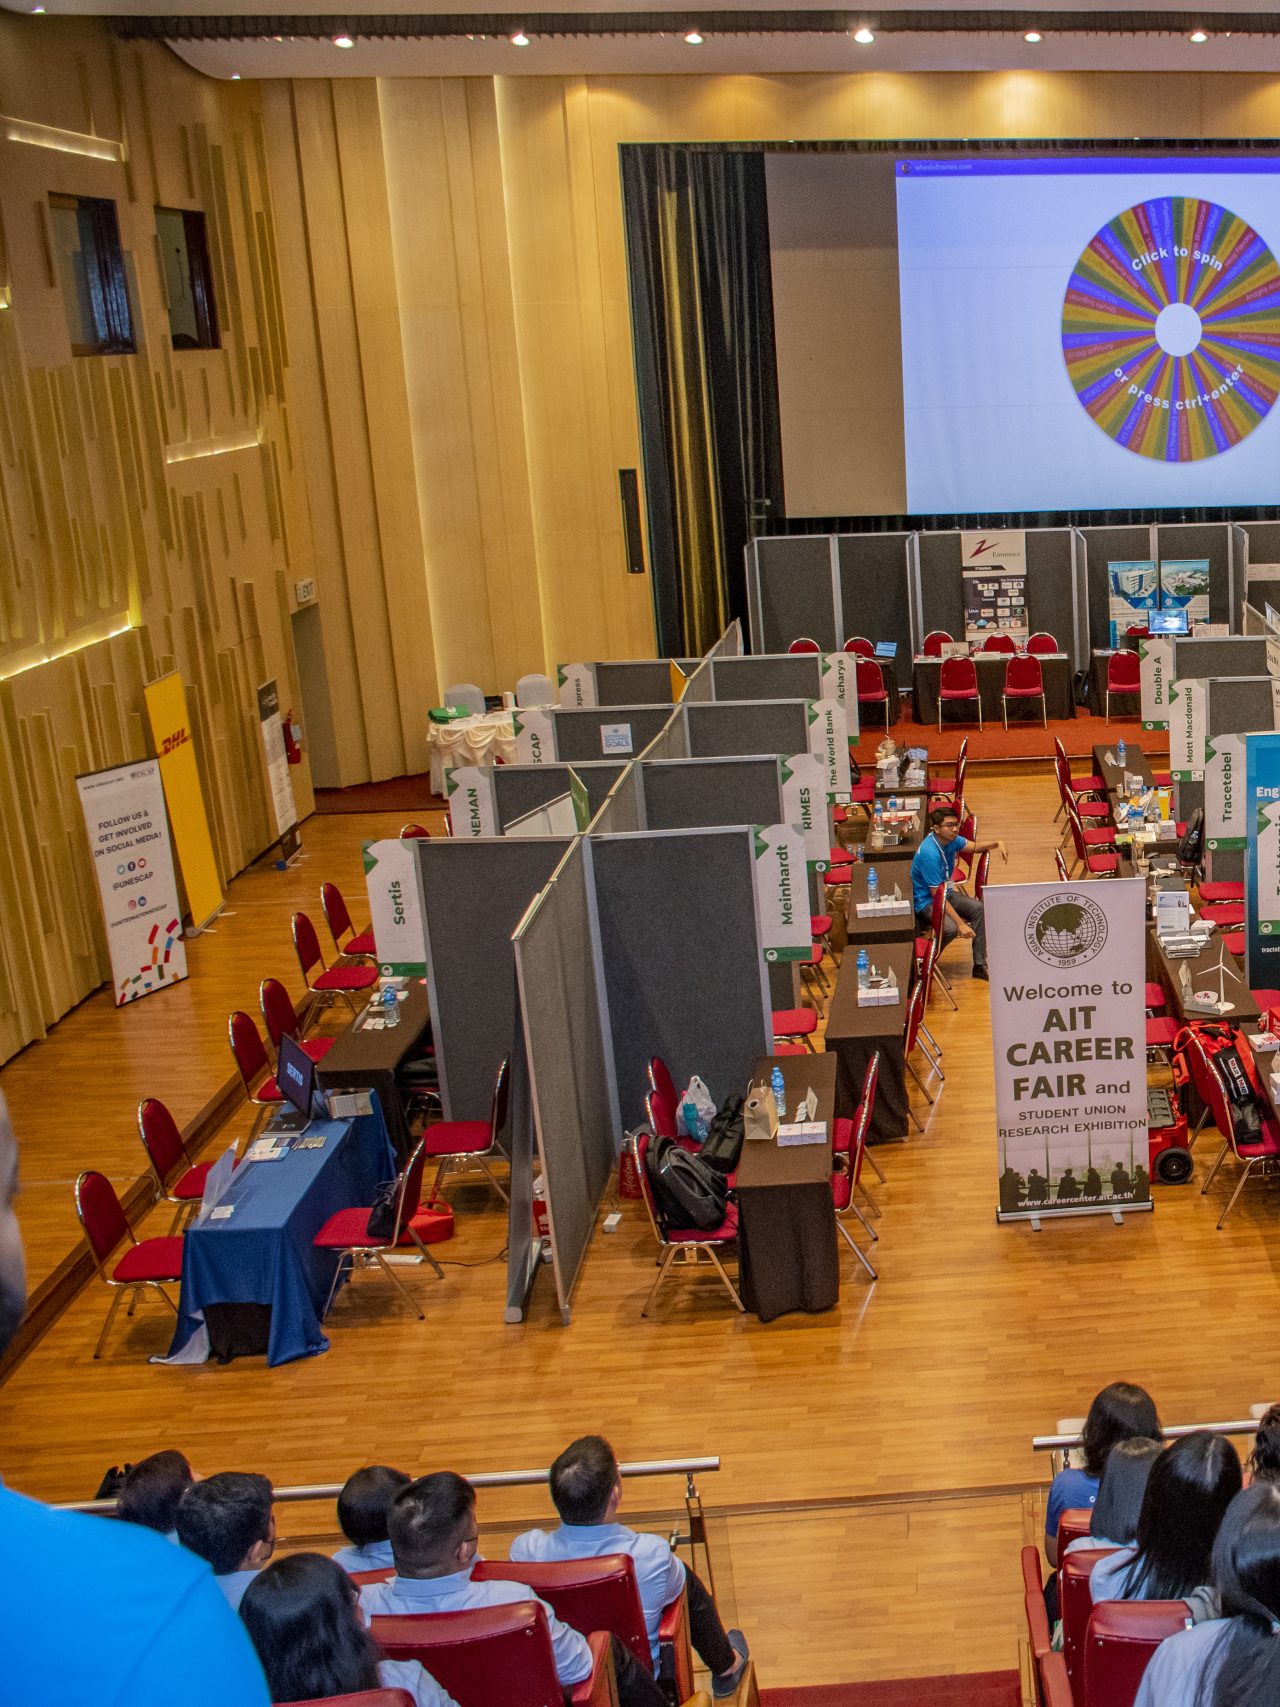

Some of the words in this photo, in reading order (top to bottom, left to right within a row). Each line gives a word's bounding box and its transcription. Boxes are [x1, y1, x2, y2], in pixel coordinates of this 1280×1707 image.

[1131, 247, 1169, 272] Click
[1173, 245, 1188, 257] to
[1193, 249, 1223, 271] spin
[1114, 368, 1129, 383] or
[1128, 383, 1170, 410] press
[1175, 364, 1244, 410] ctrl+enter
[1154, 656, 1162, 665] A
[1153, 666, 1163, 705] Double
[825, 709, 834, 729] Bank
[1185, 687, 1193, 735] Macdonald
[162, 728, 189, 755] DHL
[827, 732, 837, 768] World
[1186, 738, 1194, 763] Mott
[831, 769, 839, 787] The
[1221, 751, 1233, 823] Tracetebel
[98, 814, 131, 830] FOLLOW
[131, 811, 143, 821] US
[143, 809, 149, 818] &
[800, 787, 813, 830] RIMES
[94, 847, 105, 858] ON
[106, 840, 134, 854] SOCIAL
[135, 831, 162, 846] MEDIA!
[98, 832, 114, 843] GET
[115, 821, 153, 839] INVOLVED
[112, 871, 154, 891] @UNESCAP
[778, 844, 794, 926] Meinhardt
[392, 880, 405, 925] Sertis
[1028, 896, 1062, 927] INSTITUTE
[1066, 894, 1079, 903] OF
[1082, 899, 1106, 955] TECHNOLOGY
[1028, 926, 1045, 957] ASIAN
[1057, 957, 1077, 967] 1959
[1003, 983, 1103, 1002] Welcome
[1111, 980, 1133, 996] to
[1042, 1005, 1097, 1033] AIT
[1005, 1036, 1135, 1067] CAREER
[286, 1062, 304, 1087] SERTIS
[1012, 1073, 1088, 1102] FAIR
[1094, 1080, 1131, 1095] and
[1018, 1106, 1080, 1122] STUDENT
[1084, 1104, 1126, 1117] UNION
[999, 1122, 1070, 1139] RESEARCH
[1074, 1118, 1147, 1133] EXHIBITION
[1017, 1191, 1134, 1208] www.careercenter.ait.ac.th
